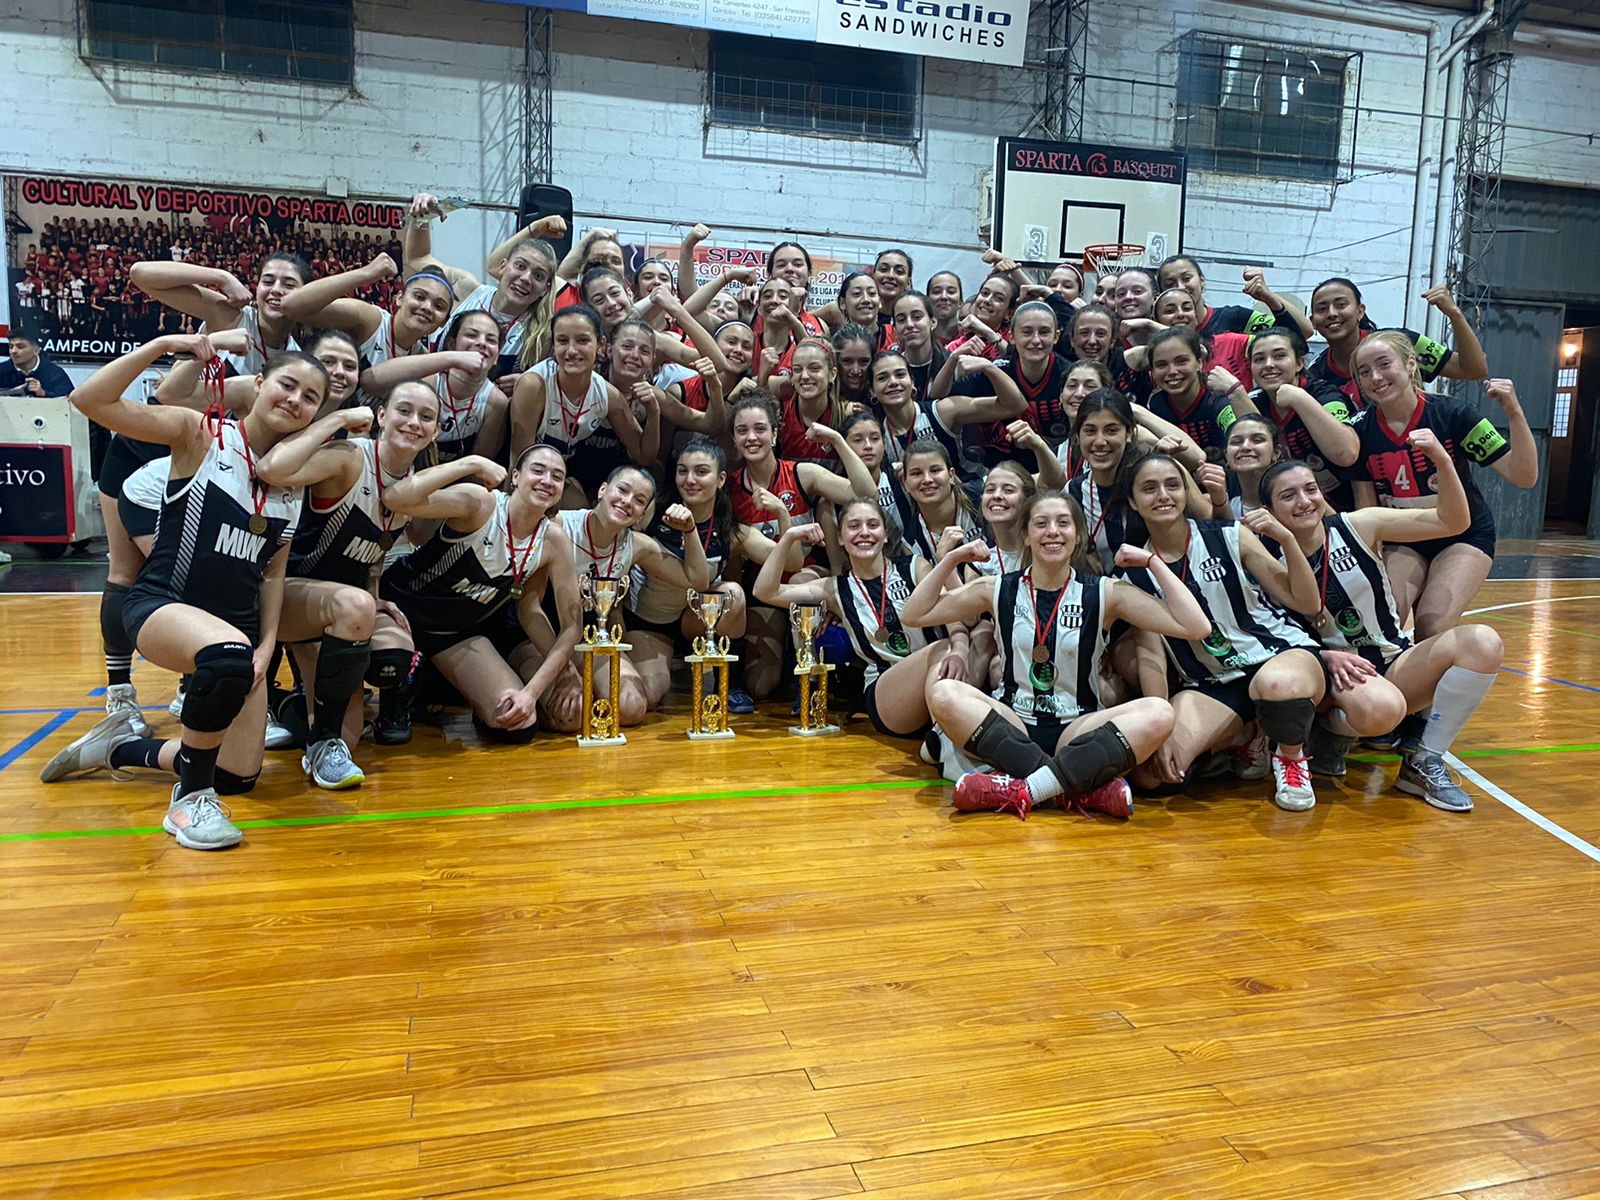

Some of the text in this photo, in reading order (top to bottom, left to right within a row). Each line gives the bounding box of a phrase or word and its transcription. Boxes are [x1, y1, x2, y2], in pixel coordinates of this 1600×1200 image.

[839, 11, 1006, 48] SANDWICHES
[1015, 149, 1177, 180] SPARTA BASQUET
[24, 180, 137, 209] CULTURAL
[137, 186, 154, 210] Y
[156, 188, 273, 218] DEPORTIVO
[276, 195, 350, 224] SPARTA
[1029, 226, 1045, 259] 3
[1151, 234, 1166, 267] 3
[818, 271, 846, 285] 201
[1394, 464, 1411, 490] 4
